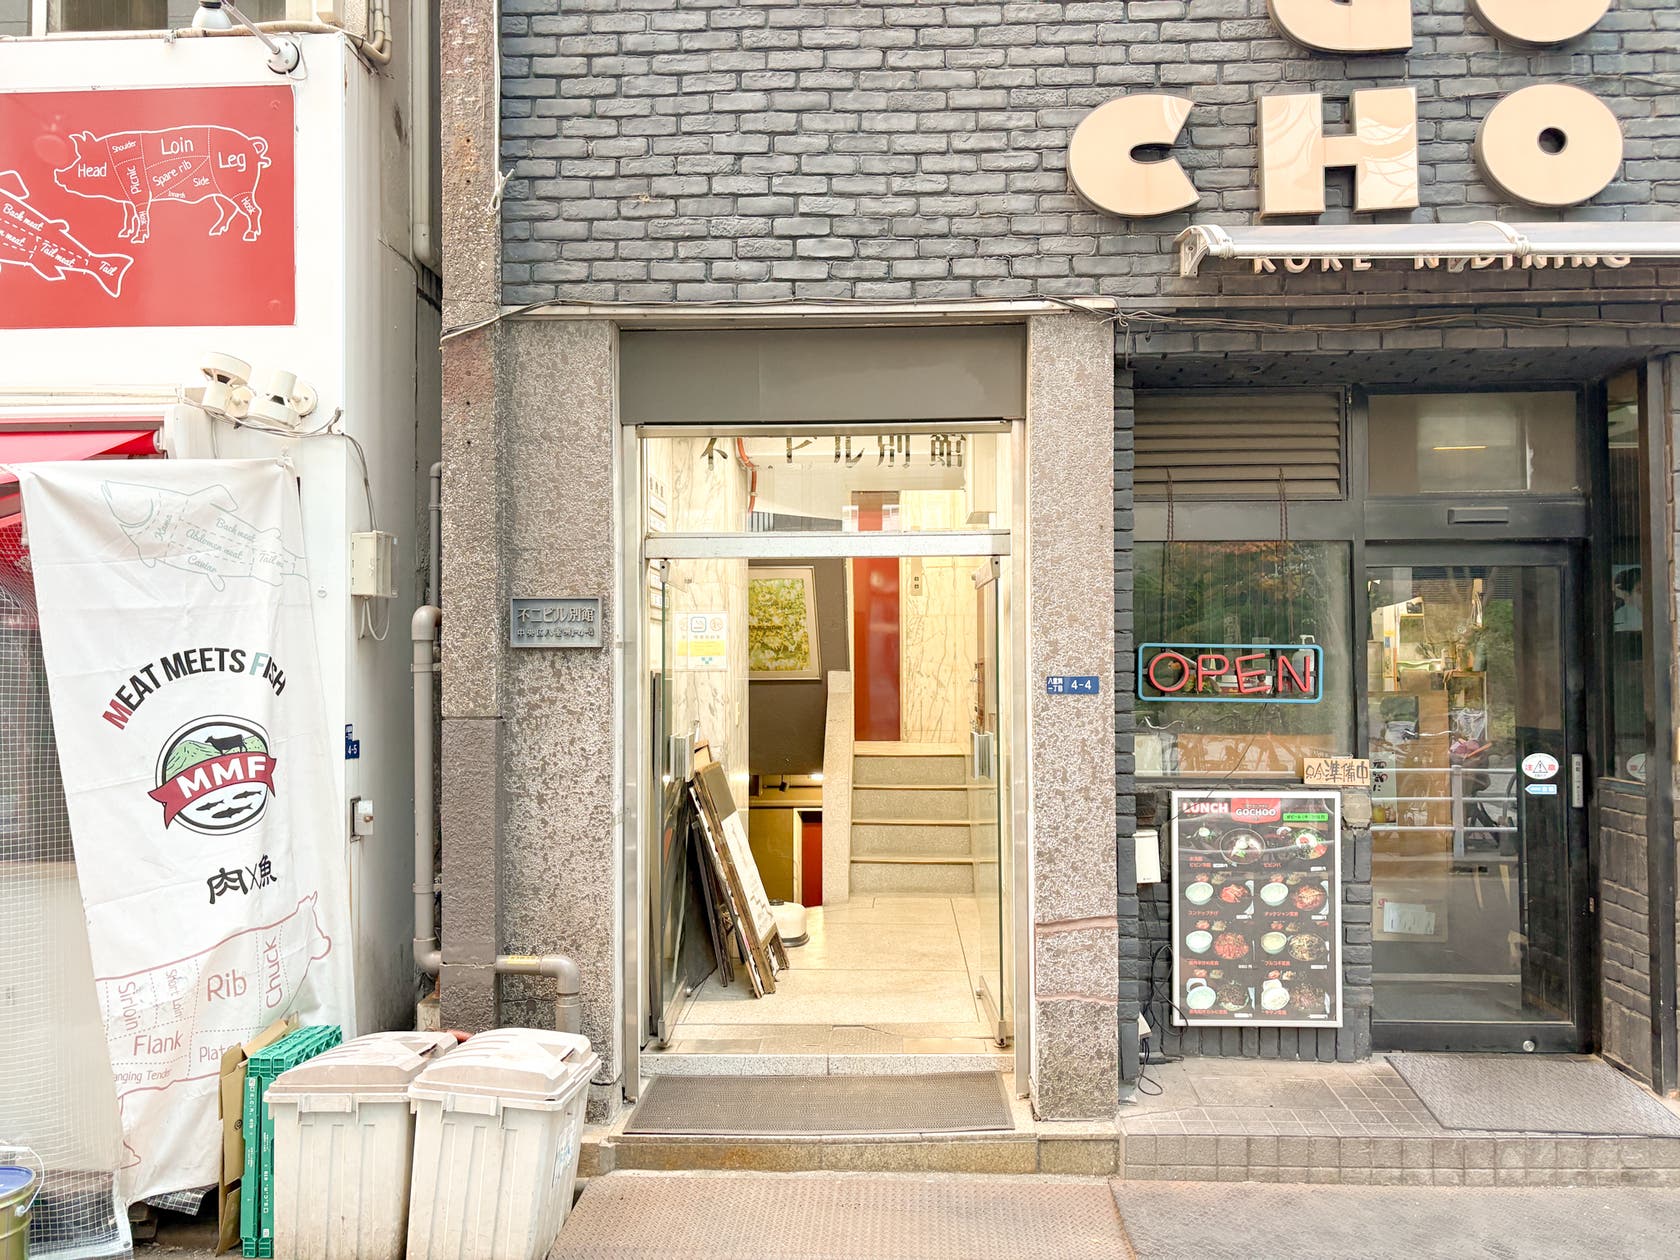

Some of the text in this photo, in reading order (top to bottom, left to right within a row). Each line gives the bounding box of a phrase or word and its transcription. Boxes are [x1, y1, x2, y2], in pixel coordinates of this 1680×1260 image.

[160, 136, 194, 156] Loin
[1067, 83, 1624, 218] CHO
[78, 162, 107, 178] Head
[218, 151, 247, 172] Leg
[152, 160, 192, 187] Spare rib
[193, 176, 210, 187] Side
[3, 203, 45, 232] Back meat
[5, 233, 26, 247] meat
[40, 242, 76, 268] Tail meat
[99, 261, 118, 276] Tail
[216, 517, 239, 537] Back
[185, 528, 222, 551] Abdomen
[187, 554, 218, 573] Caviar
[517, 606, 596, 624] 不二ビル別館
[1149, 652, 1311, 694] OPEN
[102, 647, 286, 731] MEAT MEETS FISH
[1071, 679, 1092, 691] 4-4
[176, 756, 266, 799] MMF
[1182, 802, 1276, 817] LUNCH GOCHOO
[263, 936, 283, 1008] Chuck
[207, 969, 247, 1002] Rib
[118, 981, 140, 1032] Sirloin
[133, 1030, 183, 1056] Flank
[199, 1044, 235, 1063] Plat
